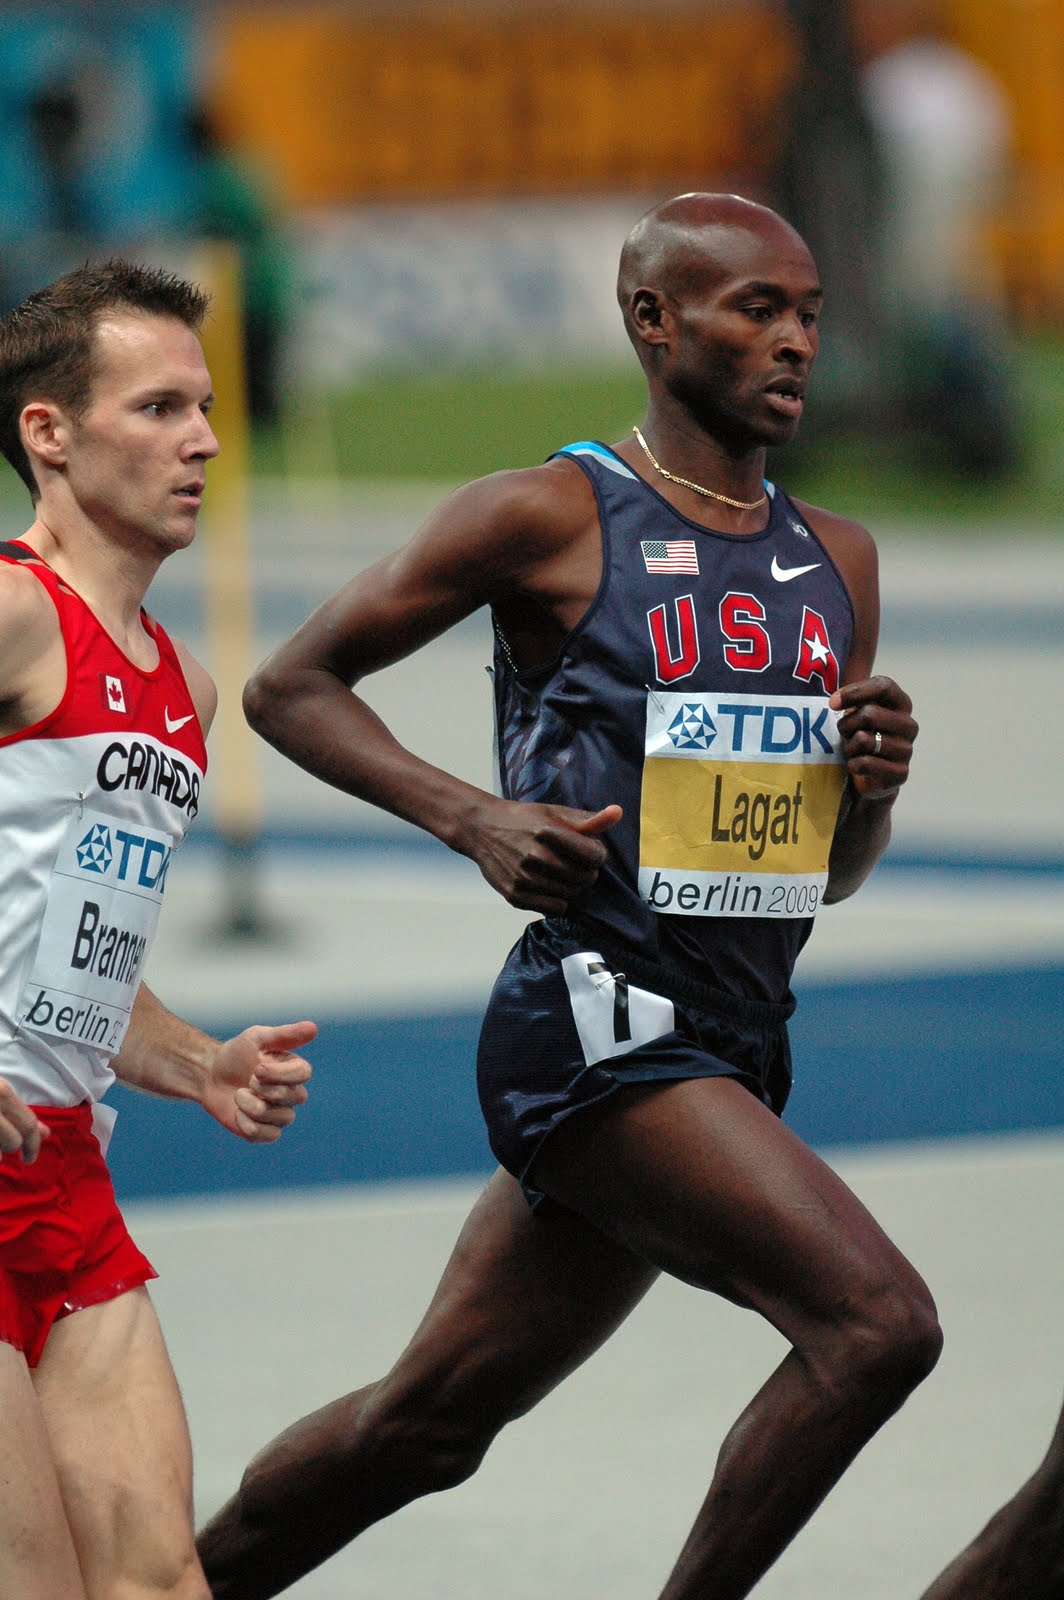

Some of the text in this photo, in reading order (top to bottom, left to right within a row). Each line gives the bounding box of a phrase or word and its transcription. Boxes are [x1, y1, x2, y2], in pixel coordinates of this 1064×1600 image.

[647, 592, 839, 696] USA
[717, 703, 834, 754] TDK
[97, 741, 200, 819] CANADA
[711, 774, 803, 861] Lagat
[649, 872, 819, 914] berlin 2009
[25, 991, 110, 1044] berlin
